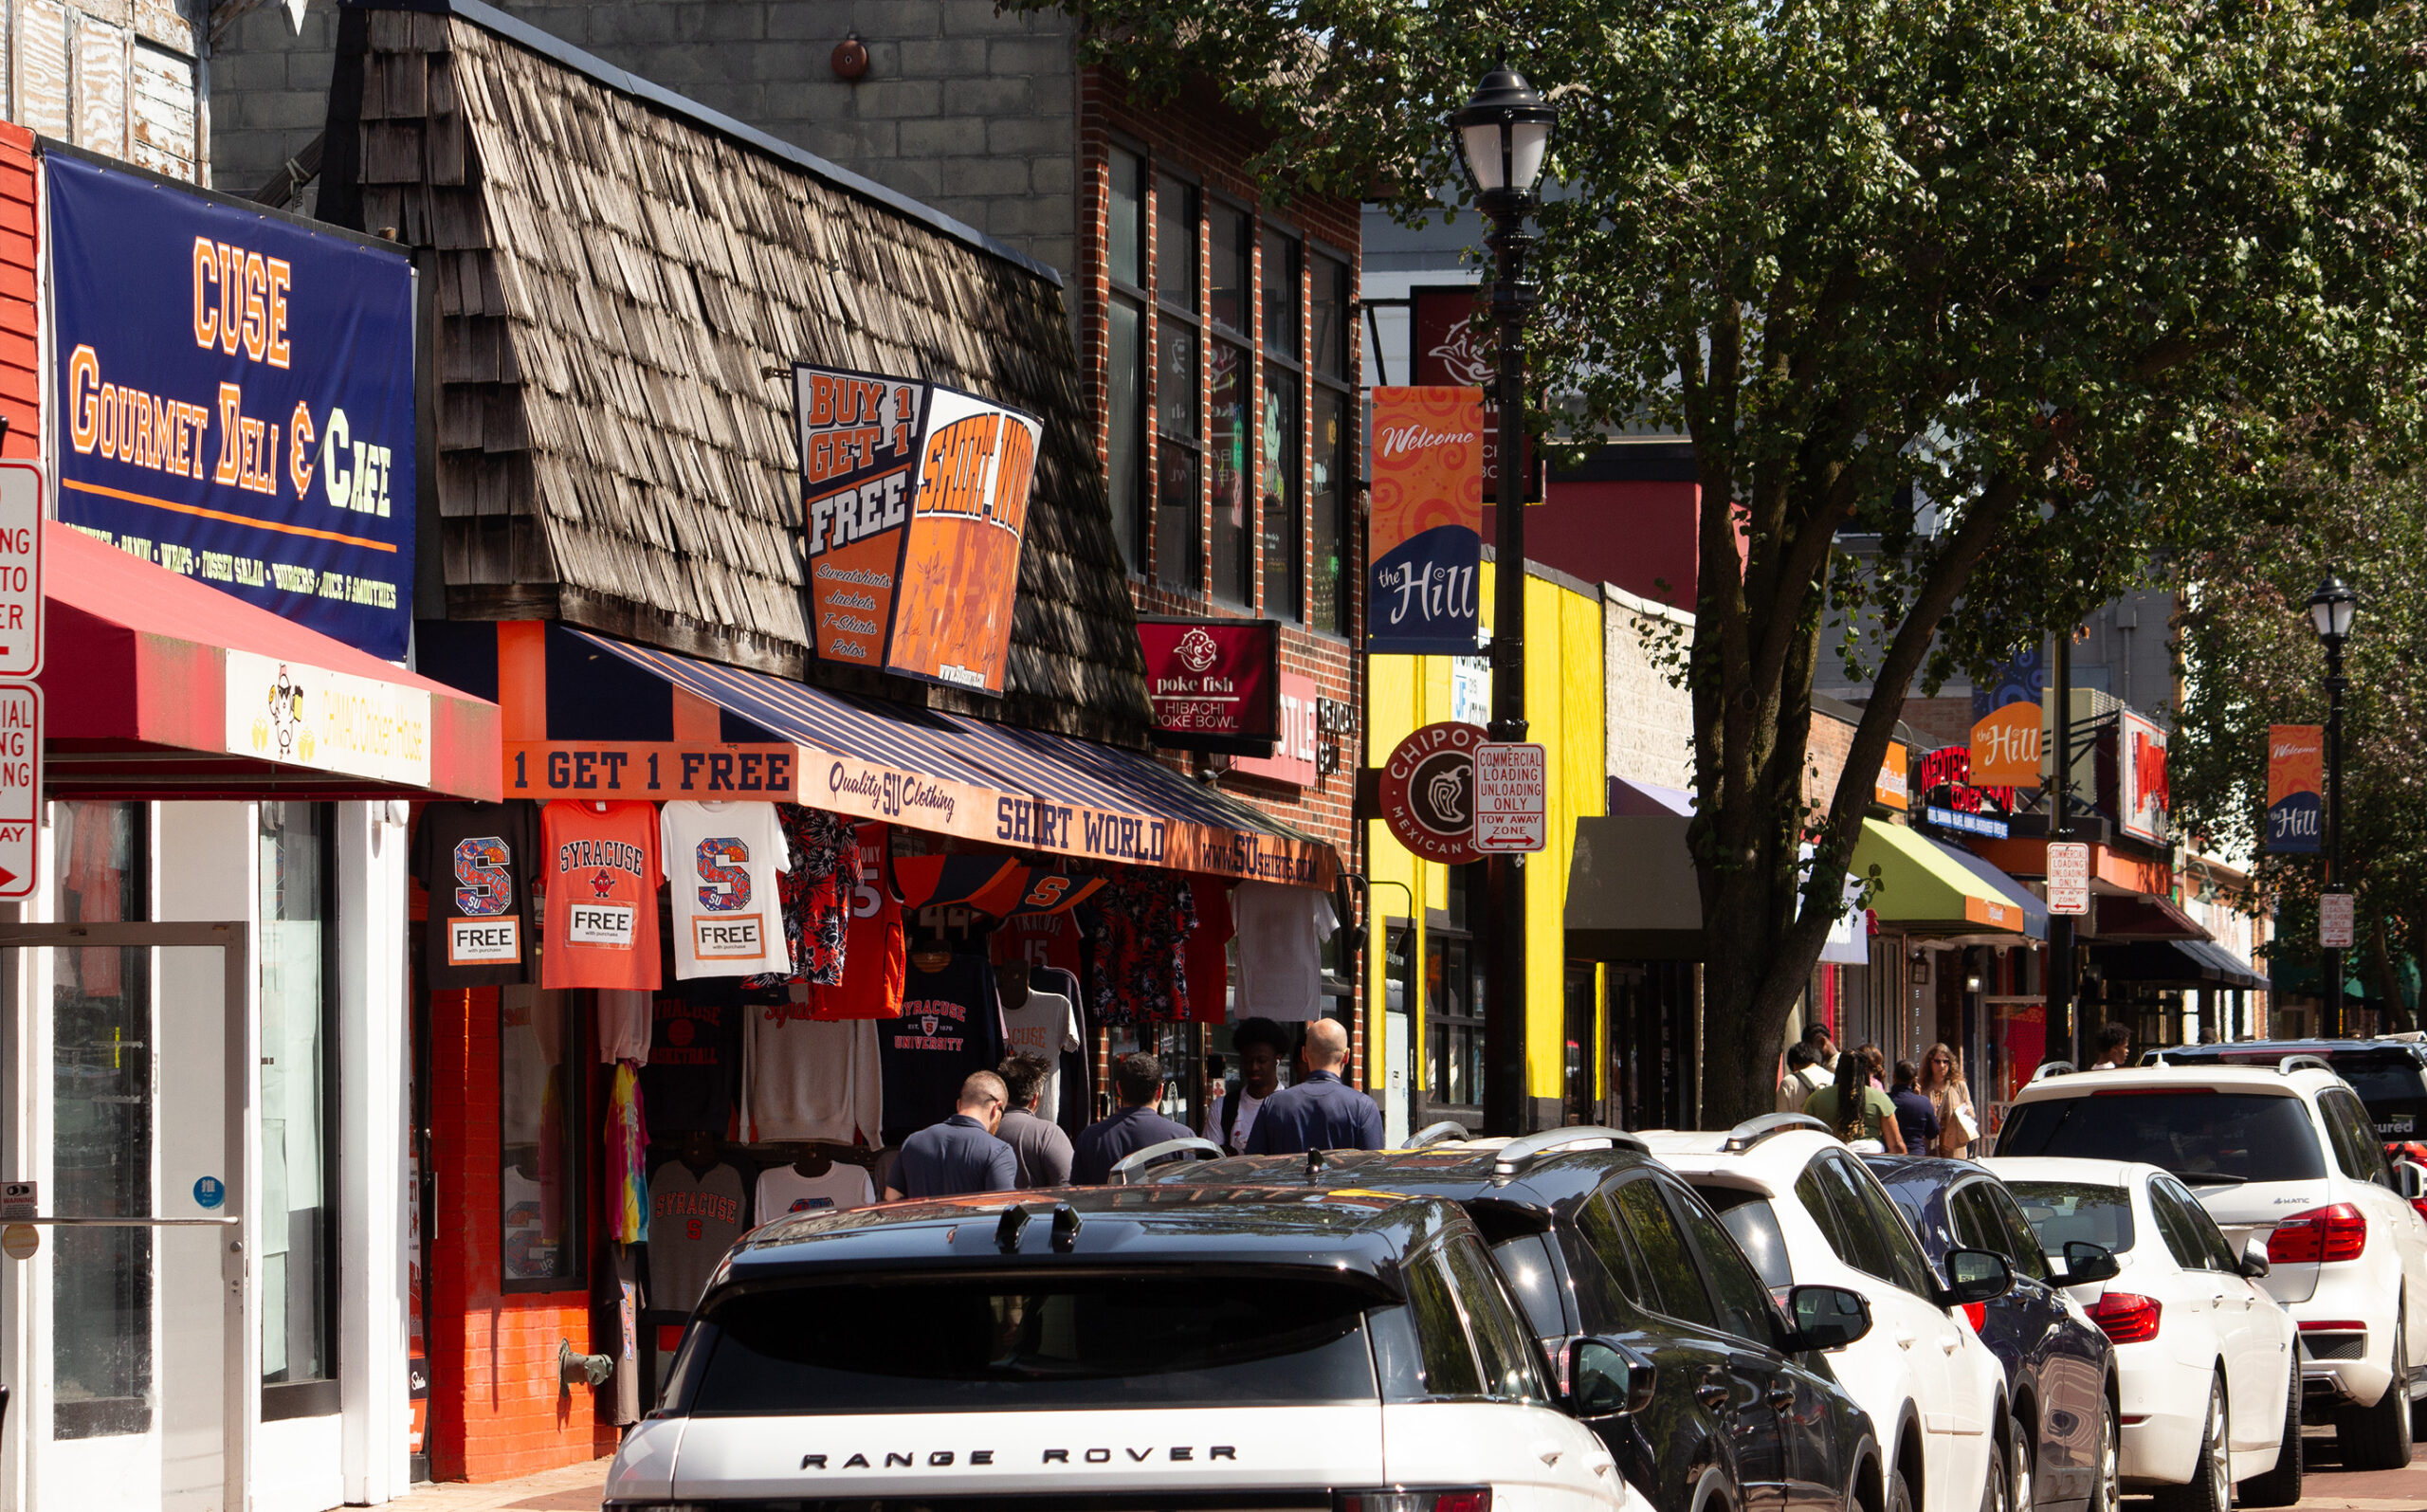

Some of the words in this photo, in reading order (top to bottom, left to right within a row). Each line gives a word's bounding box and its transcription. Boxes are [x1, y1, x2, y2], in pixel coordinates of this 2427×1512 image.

[193, 236, 290, 369] CUSE
[809, 373, 885, 427] BUY
[894, 387, 912, 422] 1
[808, 427, 882, 484] GET
[892, 422, 909, 457] 1
[1381, 424, 1476, 458] Welcome
[917, 412, 1000, 518] SHIRT
[809, 471, 907, 556] FREE
[160, 542, 193, 575] WRAPS
[202, 550, 233, 582] TOSSED
[234, 556, 265, 587] SALAD
[272, 563, 315, 594] BURGERS
[319, 571, 343, 600] JUICE
[352, 576, 396, 610] SMOOTHIES
[816, 563, 891, 587] Sweatshirts
[826, 590, 876, 610] Jackets
[1378, 568, 1400, 589] the
[1390, 561, 1474, 625] Hill
[821, 612, 877, 634] T-Shirts
[830, 639, 867, 658] Polos
[1157, 676, 1198, 695] poke
[1203, 676, 1233, 693] fish
[1165, 701, 1225, 716] HIBACHI
[1158, 714, 1192, 728] OKE
[1195, 715, 1239, 729] BOWL
[1390, 728, 1490, 780] CHIPOT
[1977, 730, 1991, 742] the
[1984, 724, 2039, 767] Hill
[2272, 743, 2318, 759] Welcome
[514, 751, 528, 790] 1
[547, 751, 628, 791] GET
[647, 752, 662, 791] 1
[680, 753, 791, 792] FREE
[1480, 752, 1542, 768] COMMERCIAL
[1484, 769, 1538, 781] LOADING
[829, 760, 883, 811] Quality
[883, 771, 902, 817] SU
[902, 775, 956, 824] Clothing
[1481, 784, 1542, 796] UNLOADING
[1494, 798, 1527, 811] ONLY
[996, 796, 1072, 849] SHIRT
[1083, 811, 1165, 862] WORLD
[1392, 806, 1463, 854] MEXICAN
[1481, 815, 1505, 824] TOW
[1510, 815, 1540, 824] AWAY
[1492, 827, 1526, 835] ZONE
[2276, 808, 2318, 839] Hill
[0, 827, 26, 843] AY
[559, 840, 644, 879] SYRACUSE
[1025, 875, 1070, 907] S
[575, 911, 630, 932] FREE
[456, 928, 513, 947] FREE
[701, 925, 757, 944] FREE
[894, 1035, 964, 1052] UNIVERSITY
[655, 1192, 738, 1225] SYRACUSE
[686, 1219, 703, 1241] S
[801, 1448, 995, 1470] RANGE
[1042, 1446, 1240, 1466] ROVER
